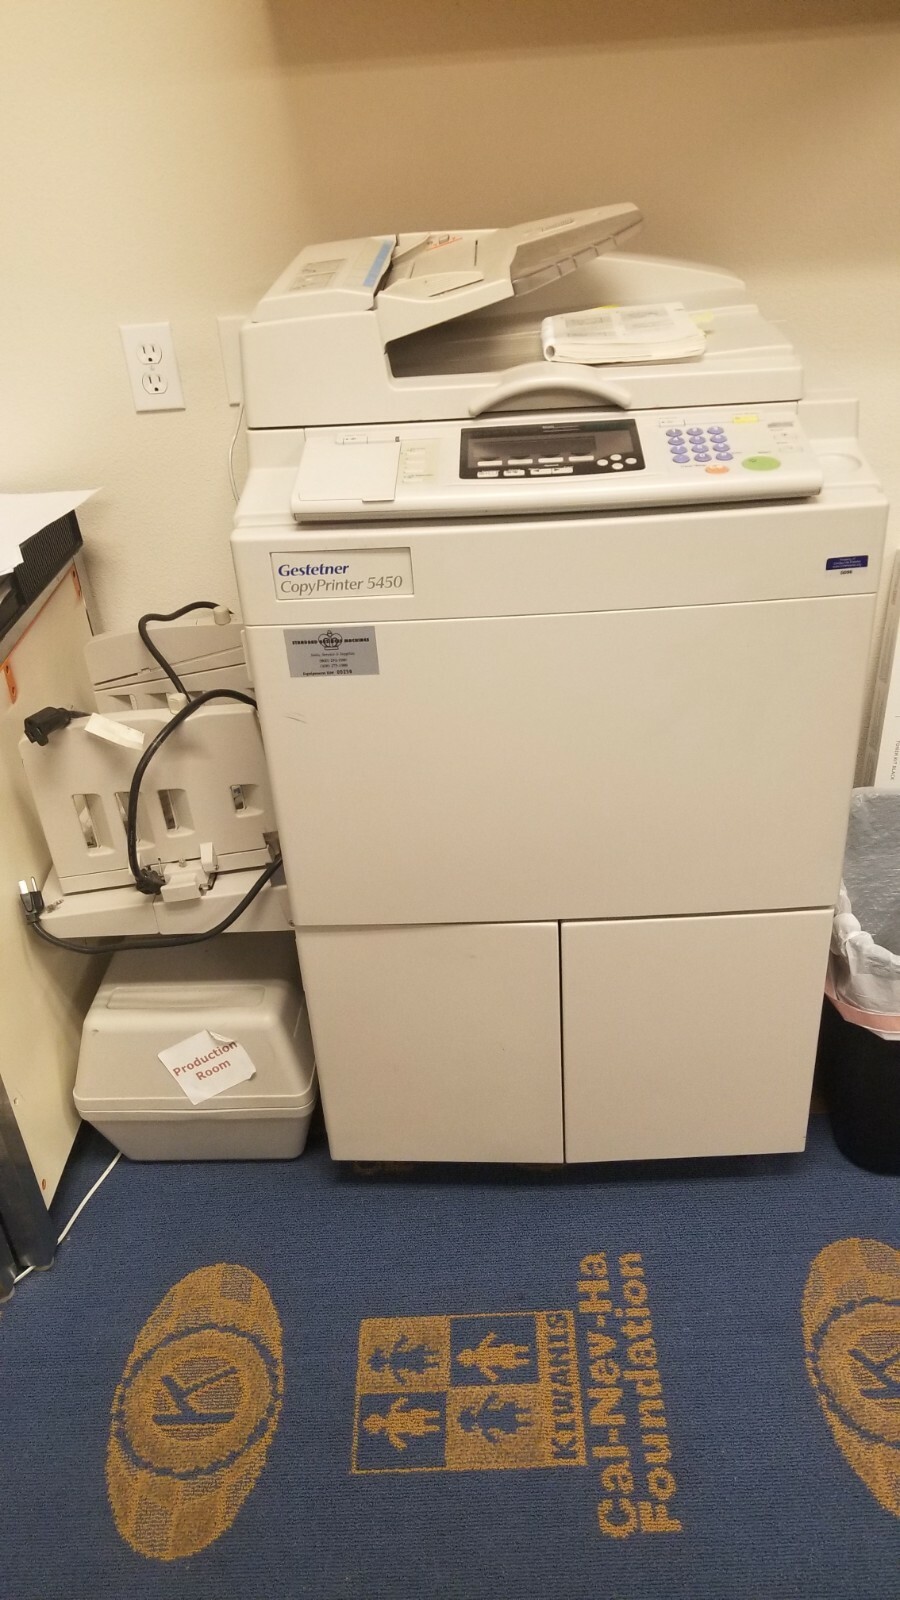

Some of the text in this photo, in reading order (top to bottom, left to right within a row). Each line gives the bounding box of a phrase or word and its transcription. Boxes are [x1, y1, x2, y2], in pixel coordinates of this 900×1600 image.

[278, 563, 349, 577] Gestetner
[280, 575, 403, 596] CopyPrinter 5450
[173, 1041, 238, 1077] Production
[195, 1060, 232, 1081] Room
[546, 1313, 578, 1460] KIWANIS
[576, 1251, 638, 1538] Cal-Nev-Ha
[614, 1252, 683, 1533] Foundation
